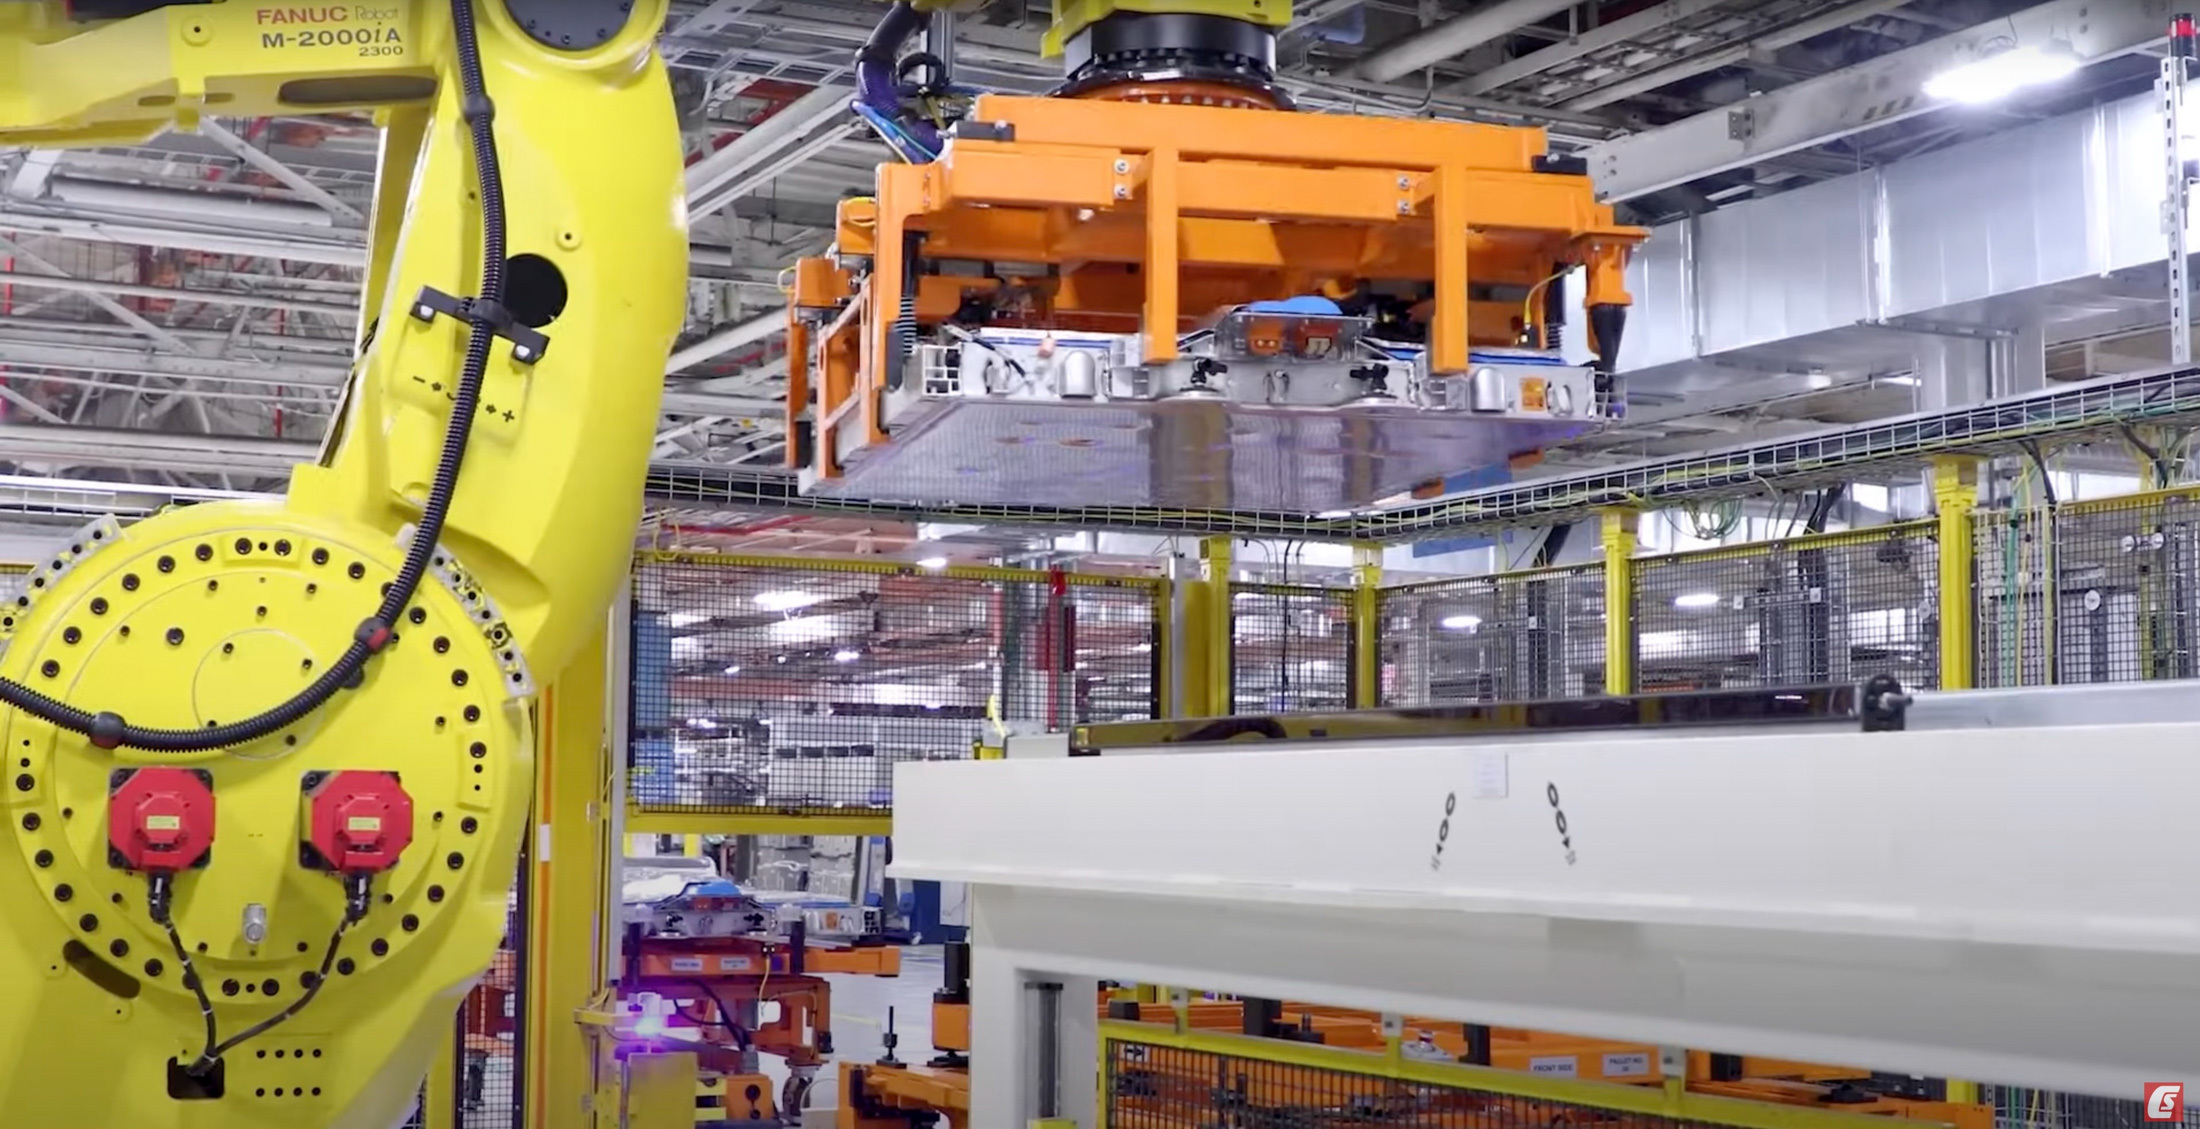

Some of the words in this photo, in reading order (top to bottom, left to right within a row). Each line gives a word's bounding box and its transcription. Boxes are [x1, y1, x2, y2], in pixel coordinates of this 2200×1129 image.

[256, 6, 348, 25] FANUC
[355, 5, 399, 21] Robot
[262, 21, 402, 48] M-2000iA
[359, 46, 404, 57] 2300
